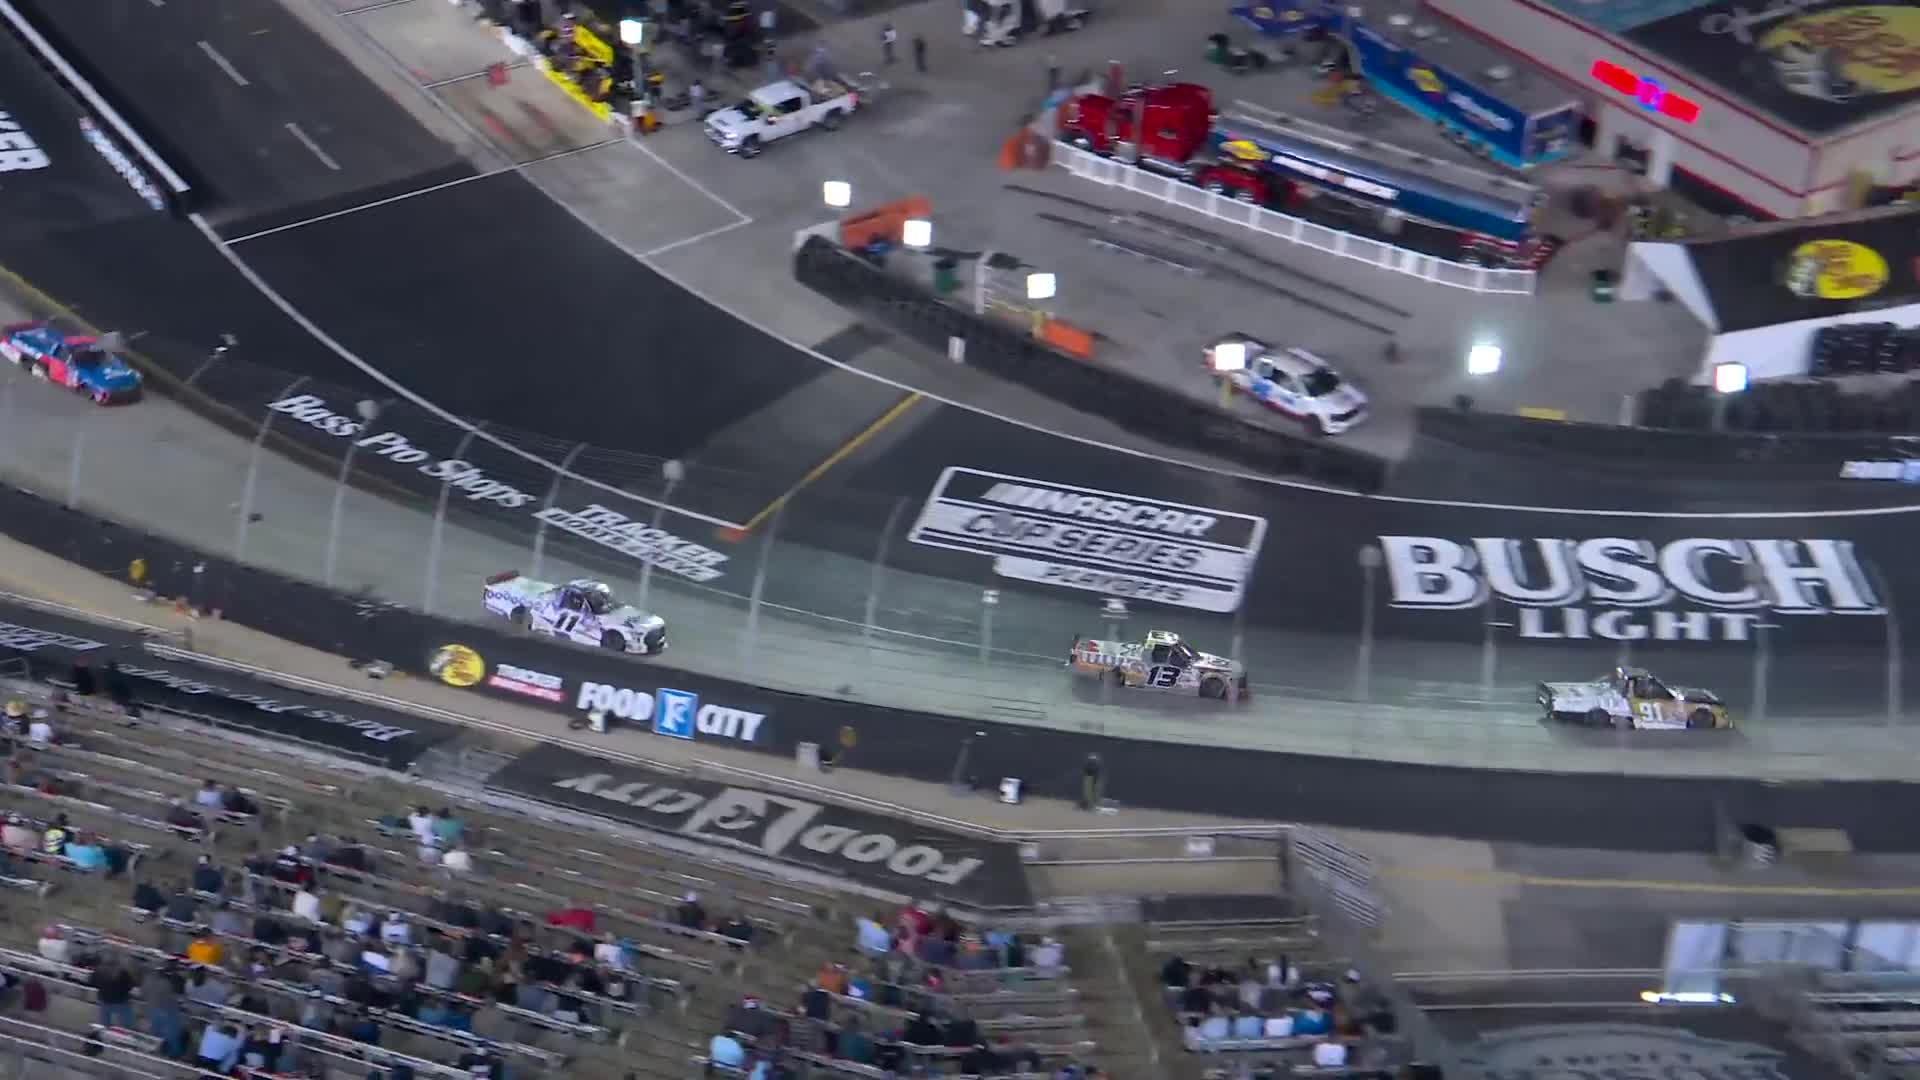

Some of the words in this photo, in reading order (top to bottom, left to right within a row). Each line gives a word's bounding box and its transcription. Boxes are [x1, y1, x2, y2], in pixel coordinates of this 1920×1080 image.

[265, 394, 365, 436] Bass
[353, 432, 430, 463] Pro
[417, 459, 536, 508] Shops
[1040, 488, 1219, 537] NASCAR
[1053, 528, 1204, 570] SERIES
[1378, 535, 1888, 615] BUSCH
[553, 611, 580, 632] 11
[1519, 607, 1761, 641] LIGHT
[1147, 665, 1181, 688] 13
[576, 681, 655, 721] FOOD
[697, 703, 767, 742] CITY
[1638, 702, 1663, 721] 91
[552, 773, 706, 814] CITY
[800, 824, 984, 886] FOOD
